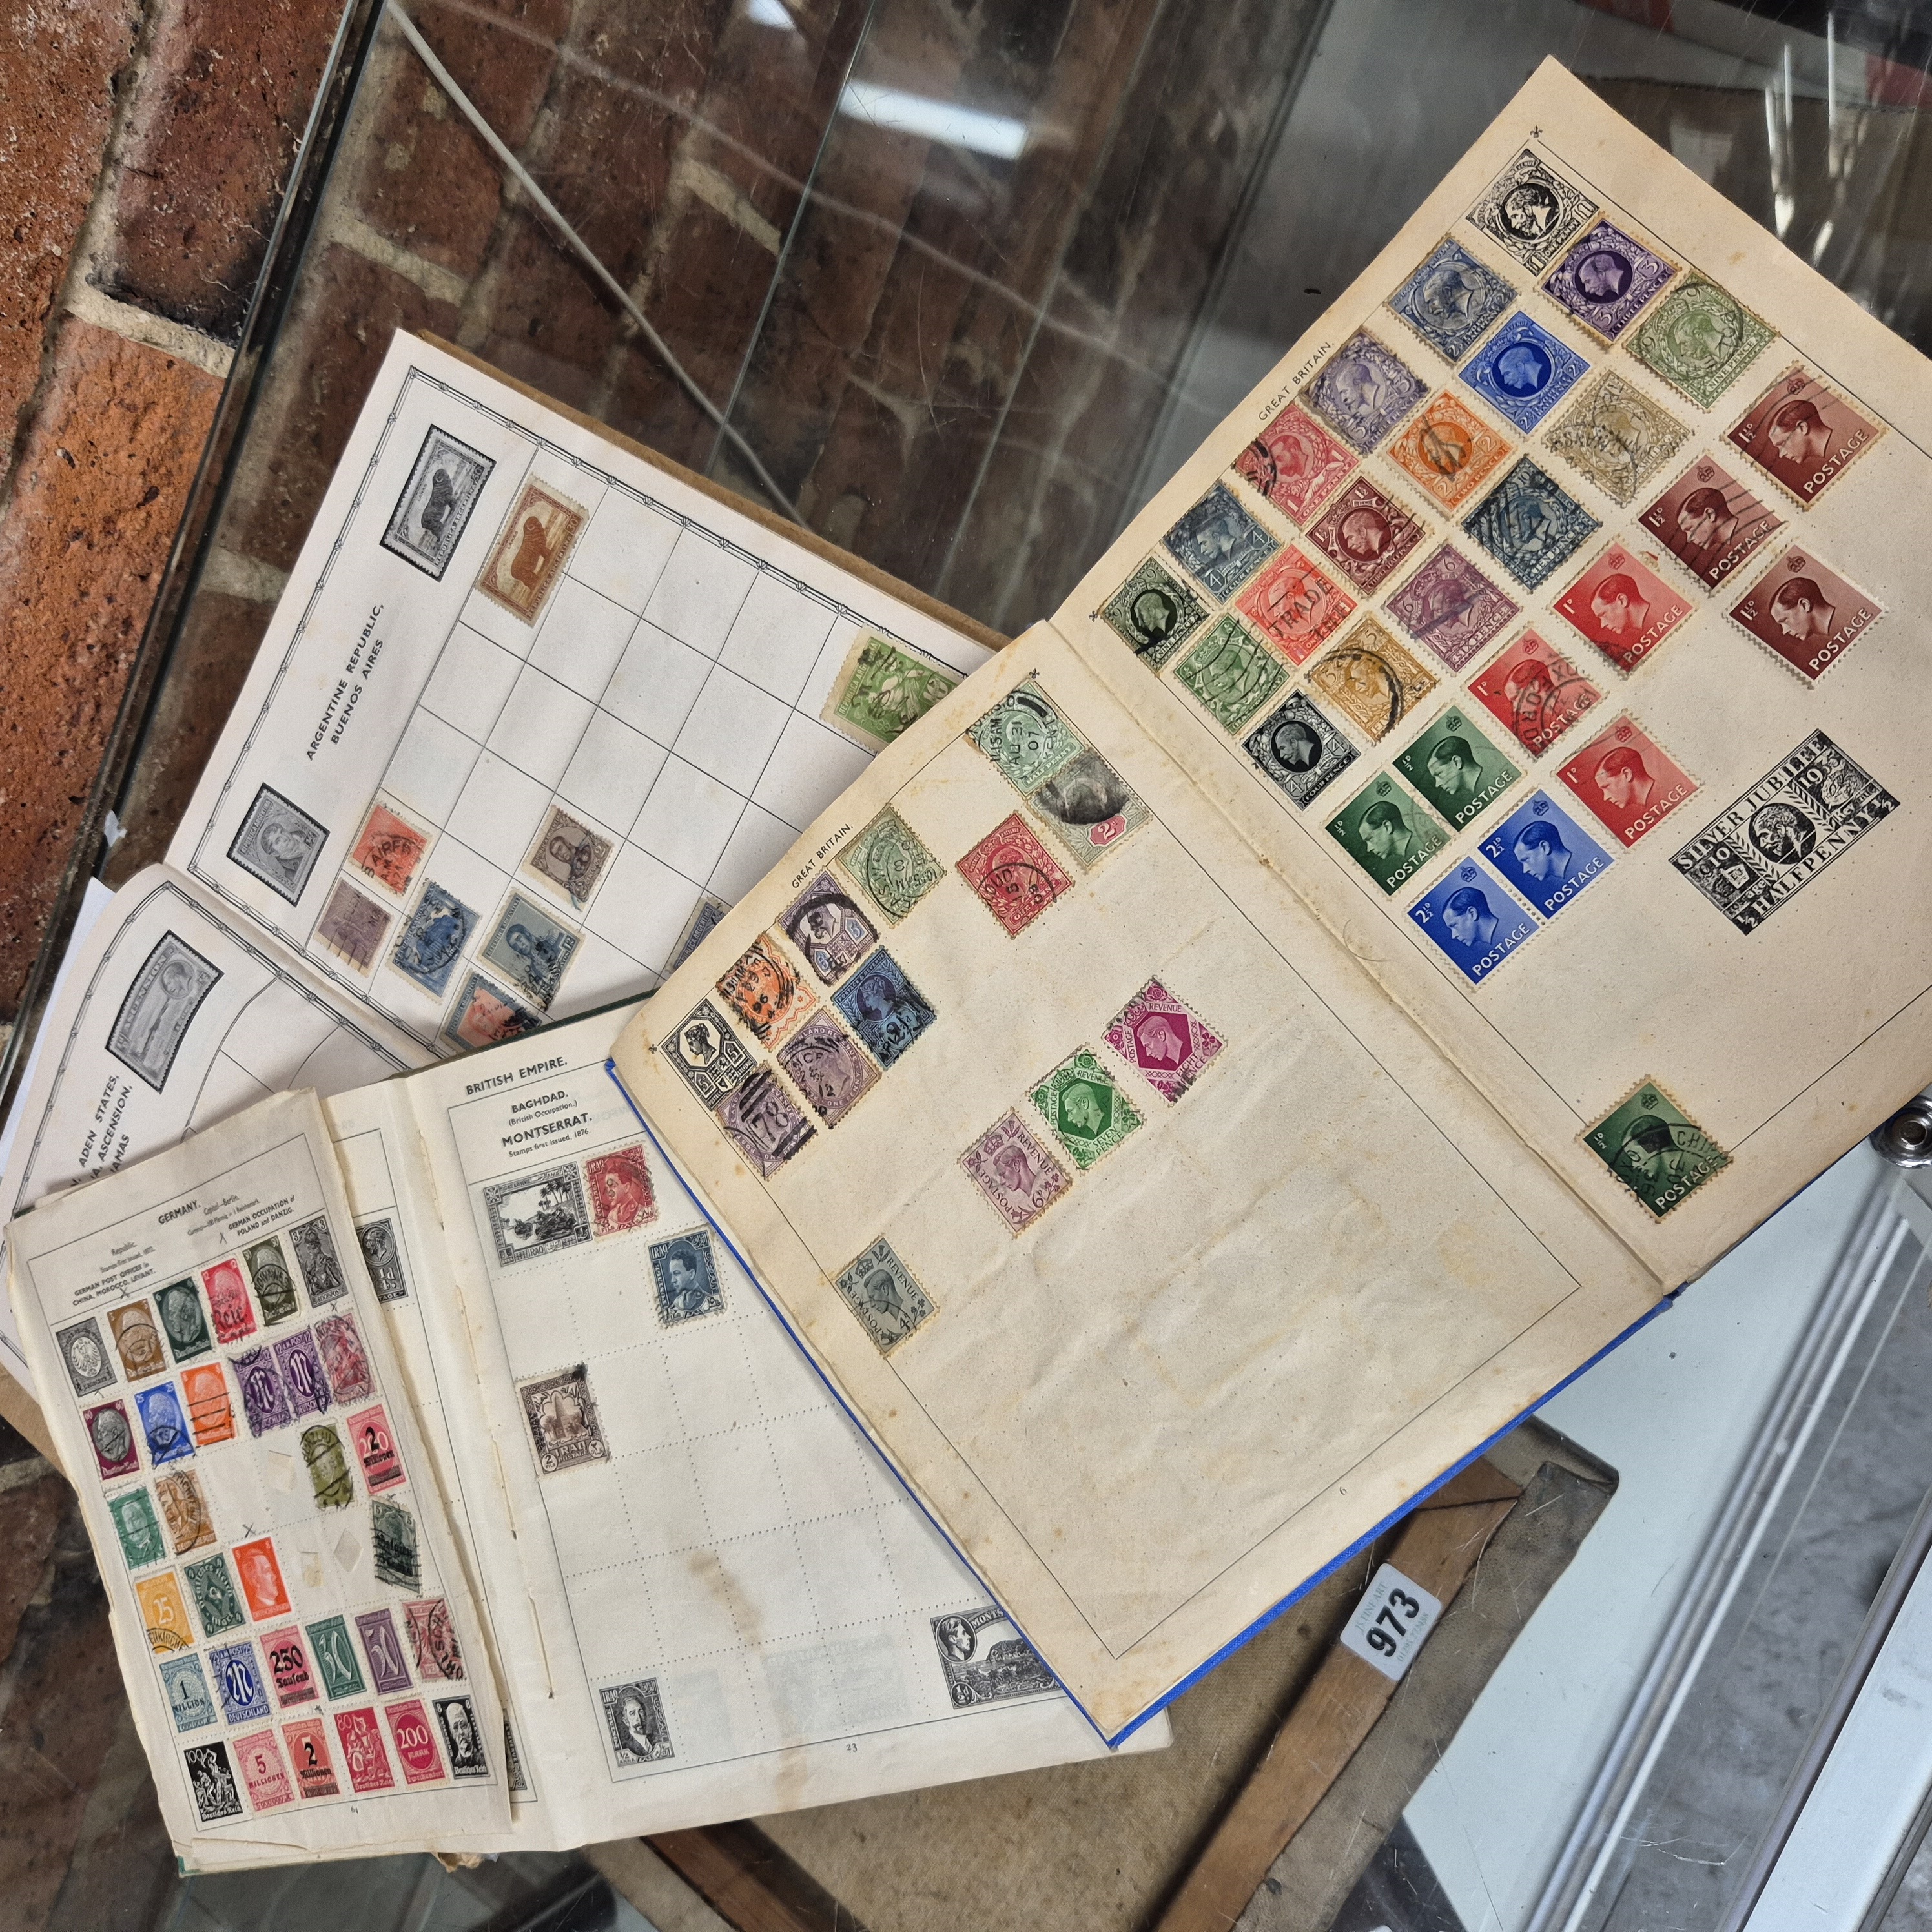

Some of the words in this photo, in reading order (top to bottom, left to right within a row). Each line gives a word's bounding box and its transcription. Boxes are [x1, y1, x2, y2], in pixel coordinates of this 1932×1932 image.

[1543, 236, 1563, 258] ONE
[1558, 218, 1580, 242] PENNY
[1613, 302, 1639, 330] THREE
[1635, 274, 1666, 306] PENCE
[1257, 385, 1291, 422] GREAT
[1291, 338, 1335, 385] BRITAIN.
[1707, 365, 1731, 389] NINE
[1726, 338, 1756, 370] PENCE
[1366, 418, 1394, 446] THREE
[1453, 478, 1475, 501] TWO
[1472, 451, 1503, 482] PENCE
[1803, 427, 1869, 495] POSTAGE
[1300, 494, 1323, 517] ONE
[1321, 463, 1352, 497] PENNY
[506, 530, 519, 550] LANAS
[1709, 519, 1773, 581] POSTAGE
[527, 577, 551, 617] REPUBLICA
[548, 534, 572, 576] ARGENTINA
[1222, 576, 1242, 595] FOUR
[1237, 545, 1273, 580] PENCE
[1529, 555, 1549, 576] TEN
[1267, 574, 1335, 641] TRADE
[1156, 638, 1176, 658] NINE
[1173, 616, 1197, 641] PENCE
[1454, 641, 1472, 659] SIX
[1468, 606, 1508, 645] PENCE
[1621, 602, 1684, 665] POSTAGE
[1808, 606, 1873, 673] POSTAGE
[304, 678, 348, 761] ARGENTINE
[345, 601, 385, 674] REPUBLIC,
[330, 683, 364, 745] BUENOS
[360, 638, 384, 680] AIRES
[838, 679, 860, 715] REPUBLICA
[1025, 766, 1046, 785] HALF
[1044, 745, 1073, 768] PENNY
[1302, 778, 1326, 802] FOUR
[1323, 755, 1351, 782] PENCE
[1454, 769, 1514, 825] POSTAGE
[1623, 781, 1689, 841] POSTAGE
[1676, 808, 1744, 872] SILVER
[1743, 735, 1828, 812] JUBILEE
[532, 838, 549, 865] REPUBLICA
[546, 811, 563, 839] ARGENTINA
[790, 858, 818, 890] GREAT
[816, 821, 854, 859] BRITAIN.
[585, 858, 601, 884] CENTAVOS
[1386, 834, 1444, 890] POSTAGE
[1751, 805, 1876, 916] HALFPENNY
[1543, 854, 1605, 912] POSTAGE
[692, 906, 713, 939] ARGENTINA
[1013, 903, 1031, 921] ONE
[562, 935, 576, 951] 12
[1471, 921, 1532, 978] POSTAGE
[837, 978, 860, 1002] POSTAGE
[863, 952, 886, 975] REVENUE
[1149, 1003, 1182, 1011] REVENUE
[1125, 1031, 1136, 1063] POSTAGE
[1175, 1052, 1200, 1078] EIGHT
[465, 1071, 514, 1096] BRITISH
[519, 1055, 568, 1078] EMPIRE.
[77, 1129, 98, 1167] ADEN
[93, 1073, 119, 1123] STATES.
[508, 1113, 533, 1127] (British
[534, 1099, 578, 1118] Occupation.)
[511, 1089, 569, 1114] BAGHDAD.
[96, 1083, 133, 1162] ASCENSION.
[501, 1111, 592, 1147] MONTSERRAT.
[1091, 1125, 1117, 1149] SEVEN
[508, 1145, 533, 1158] Stamps
[533, 1139, 548, 1150] first
[573, 1127, 591, 1138] 1876.
[1015, 1132, 1053, 1176] REVENUE
[1094, 1129, 1124, 1158] PENCE
[588, 1158, 605, 1174] IRAQ
[1654, 1154, 1719, 1211] POSTAGE
[978, 1169, 1014, 1213] POSTAGE
[157, 1198, 201, 1225] GERMANY.
[227, 1215, 251, 1231] GERMAN
[251, 1198, 290, 1220] OCCUPATION
[236, 1221, 260, 1237] POLAND
[260, 1217, 271, 1227] and
[269, 1205, 294, 1222] DANZIG.
[527, 1245, 544, 1257] IRAQ
[651, 1244, 669, 1258] IRAQ
[72, 1292, 96, 1307] CHINA,
[94, 1278, 130, 1297] MOROCCO,
[130, 1267, 156, 1283] LEVANT.
[74, 1281, 101, 1297] GERMAN
[101, 1273, 119, 1286] POST
[119, 1264, 143, 1279] OFFICES
[653, 1262, 667, 1304] POSTAGE
[885, 1257, 919, 1300] REVENUE
[848, 1289, 883, 1333] POSTAGE
[290, 1333, 304, 1346] POST
[303, 1331, 311, 1341] 12
[545, 1454, 553, 1464] 2
[555, 1441, 586, 1457] IRAQ
[558, 1450, 588, 1462] POSTAGE
[152, 1595, 175, 1625] 25
[1371, 1581, 1388, 1602] ART
[1362, 1585, 1423, 1659] 973
[229, 1645, 243, 1656] POST
[269, 1643, 304, 1676] 250
[228, 1705, 269, 1722] DEUTSCHLAND
[602, 1689, 619, 1703] IRAQ
[336, 1713, 353, 1731] 80
[397, 1723, 429, 1749] 200
[185, 1747, 203, 1765] 100
[254, 1754, 267, 1774] 5
[302, 1741, 318, 1767] 2
[845, 1742, 858, 1753] 23
